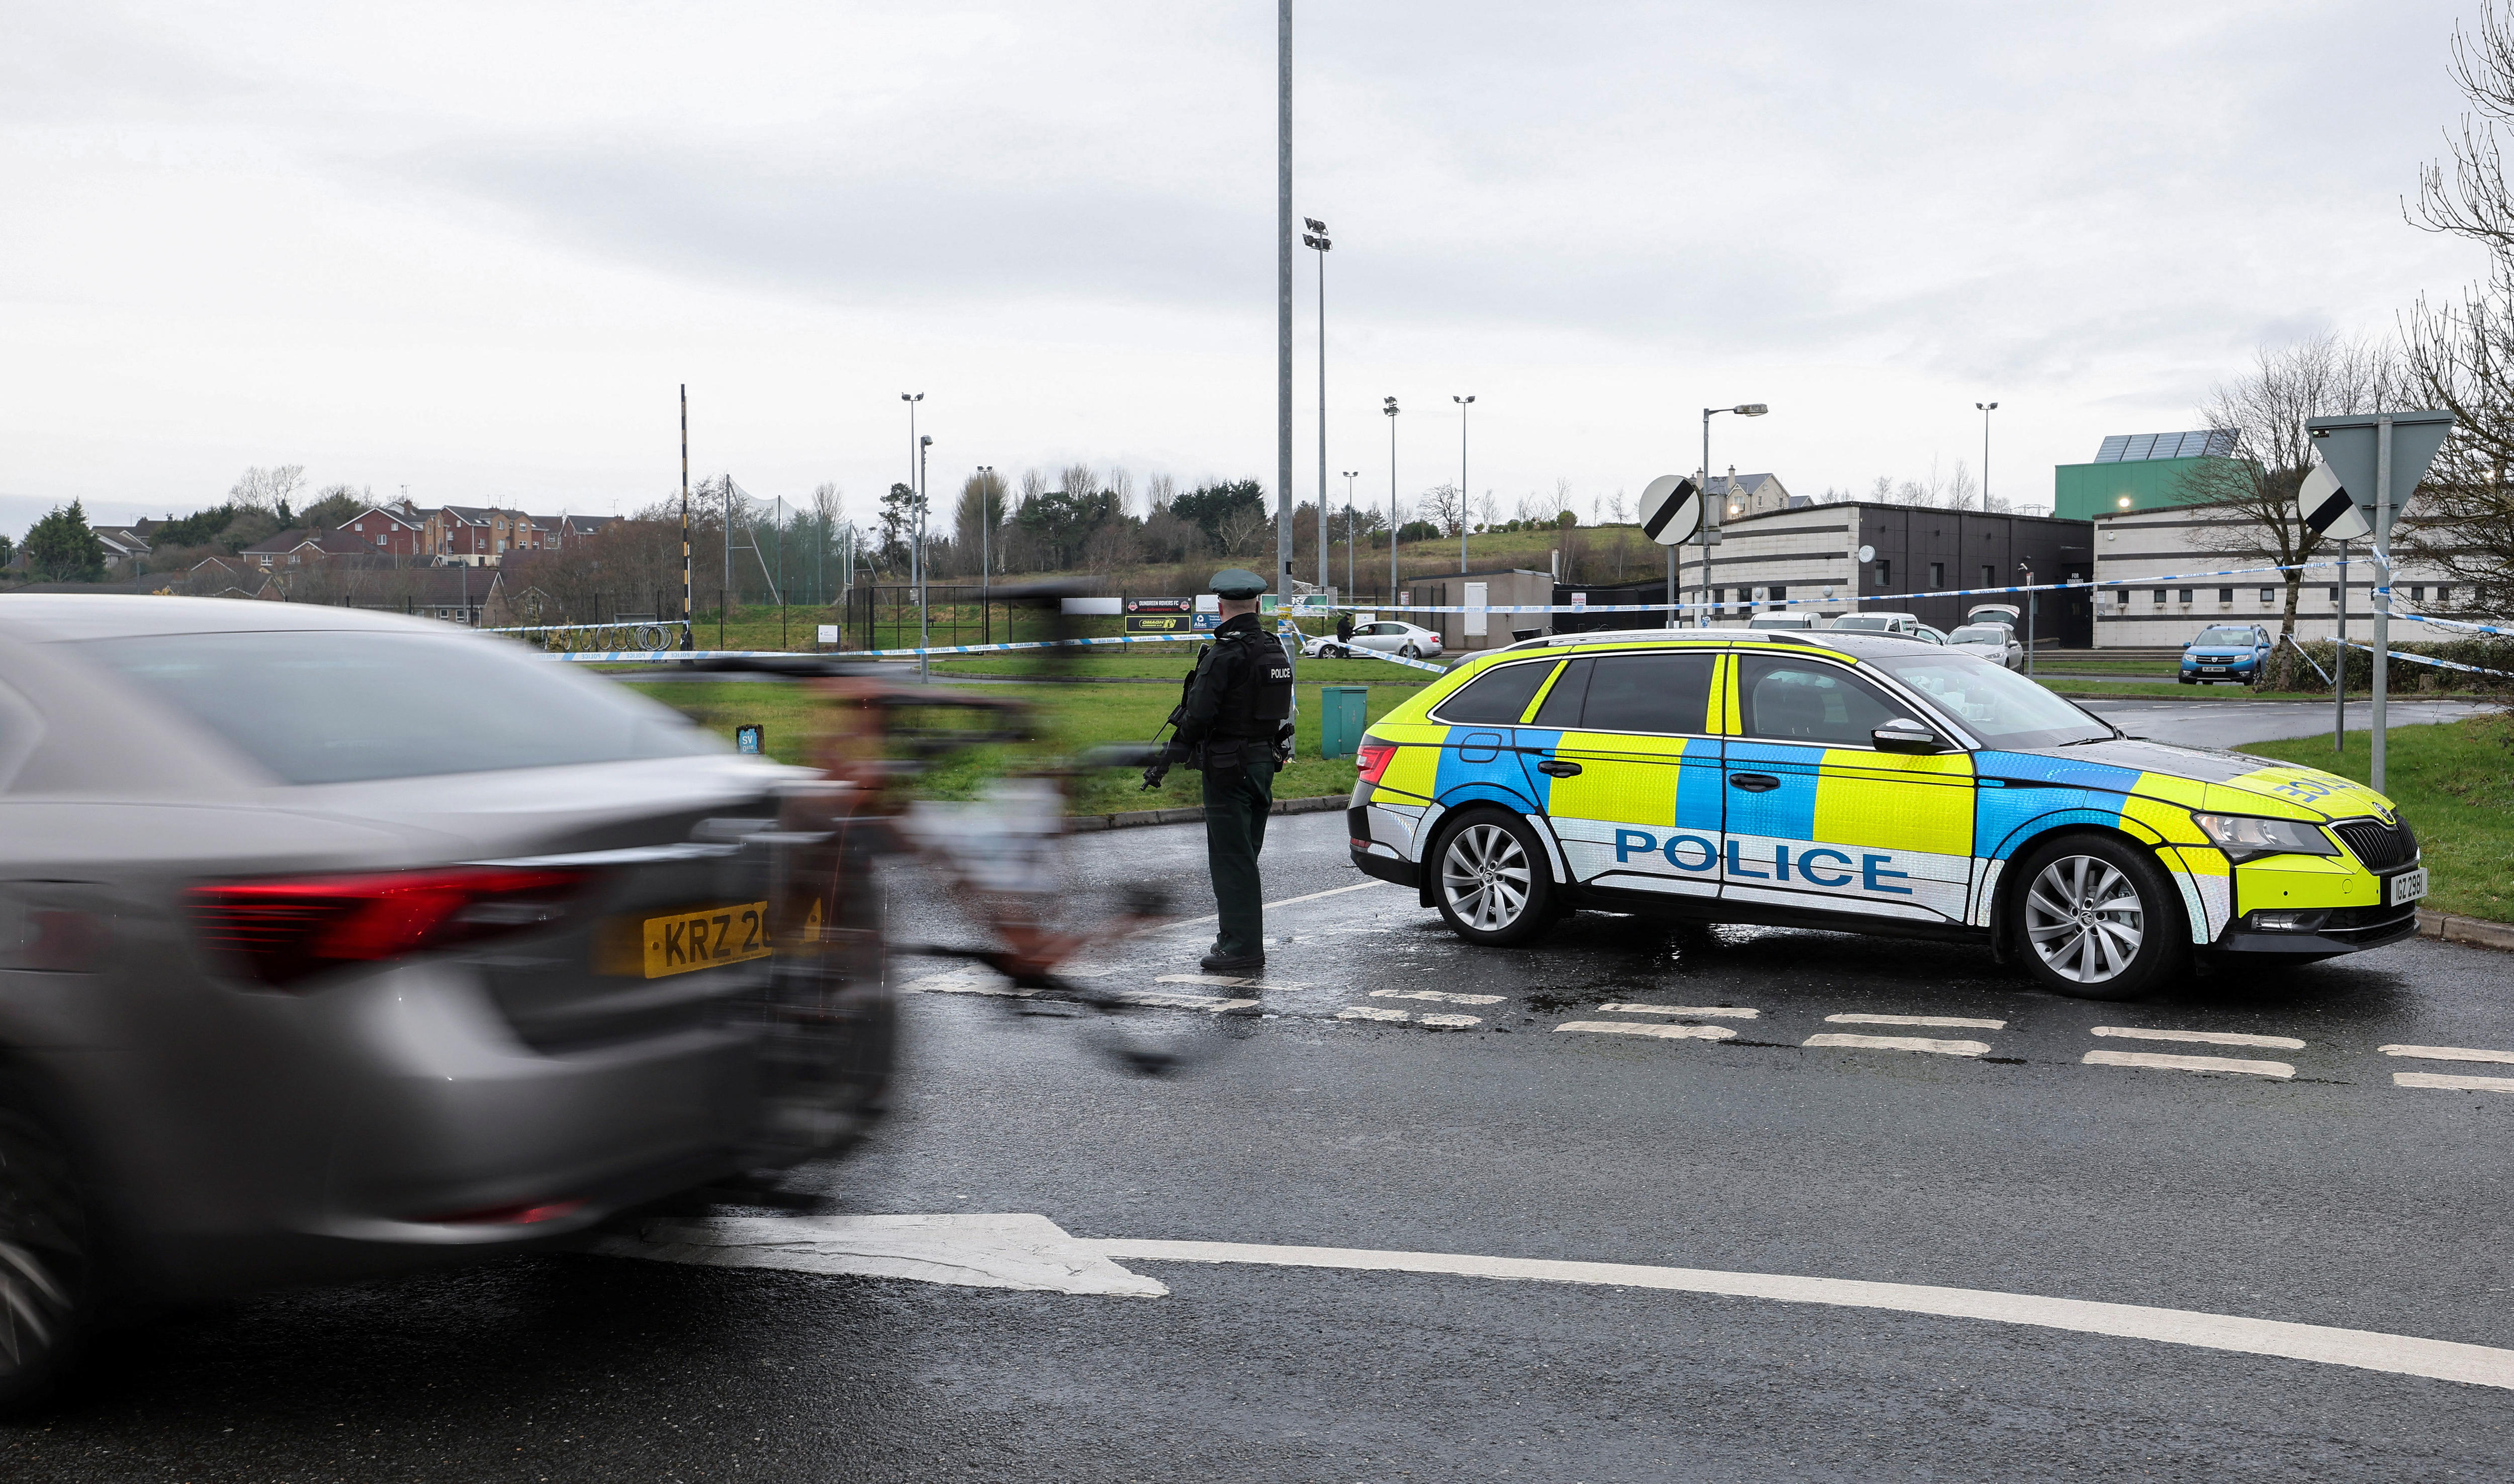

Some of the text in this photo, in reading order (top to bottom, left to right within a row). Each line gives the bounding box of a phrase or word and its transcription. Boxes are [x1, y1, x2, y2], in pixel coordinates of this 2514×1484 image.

[1271, 668, 1291, 679] POLICE
[742, 735, 753, 745] SV
[1615, 828, 1913, 895] POLICE
[2396, 873, 2422, 901] IGZ 2981
[665, 914, 731, 967] KRZ
